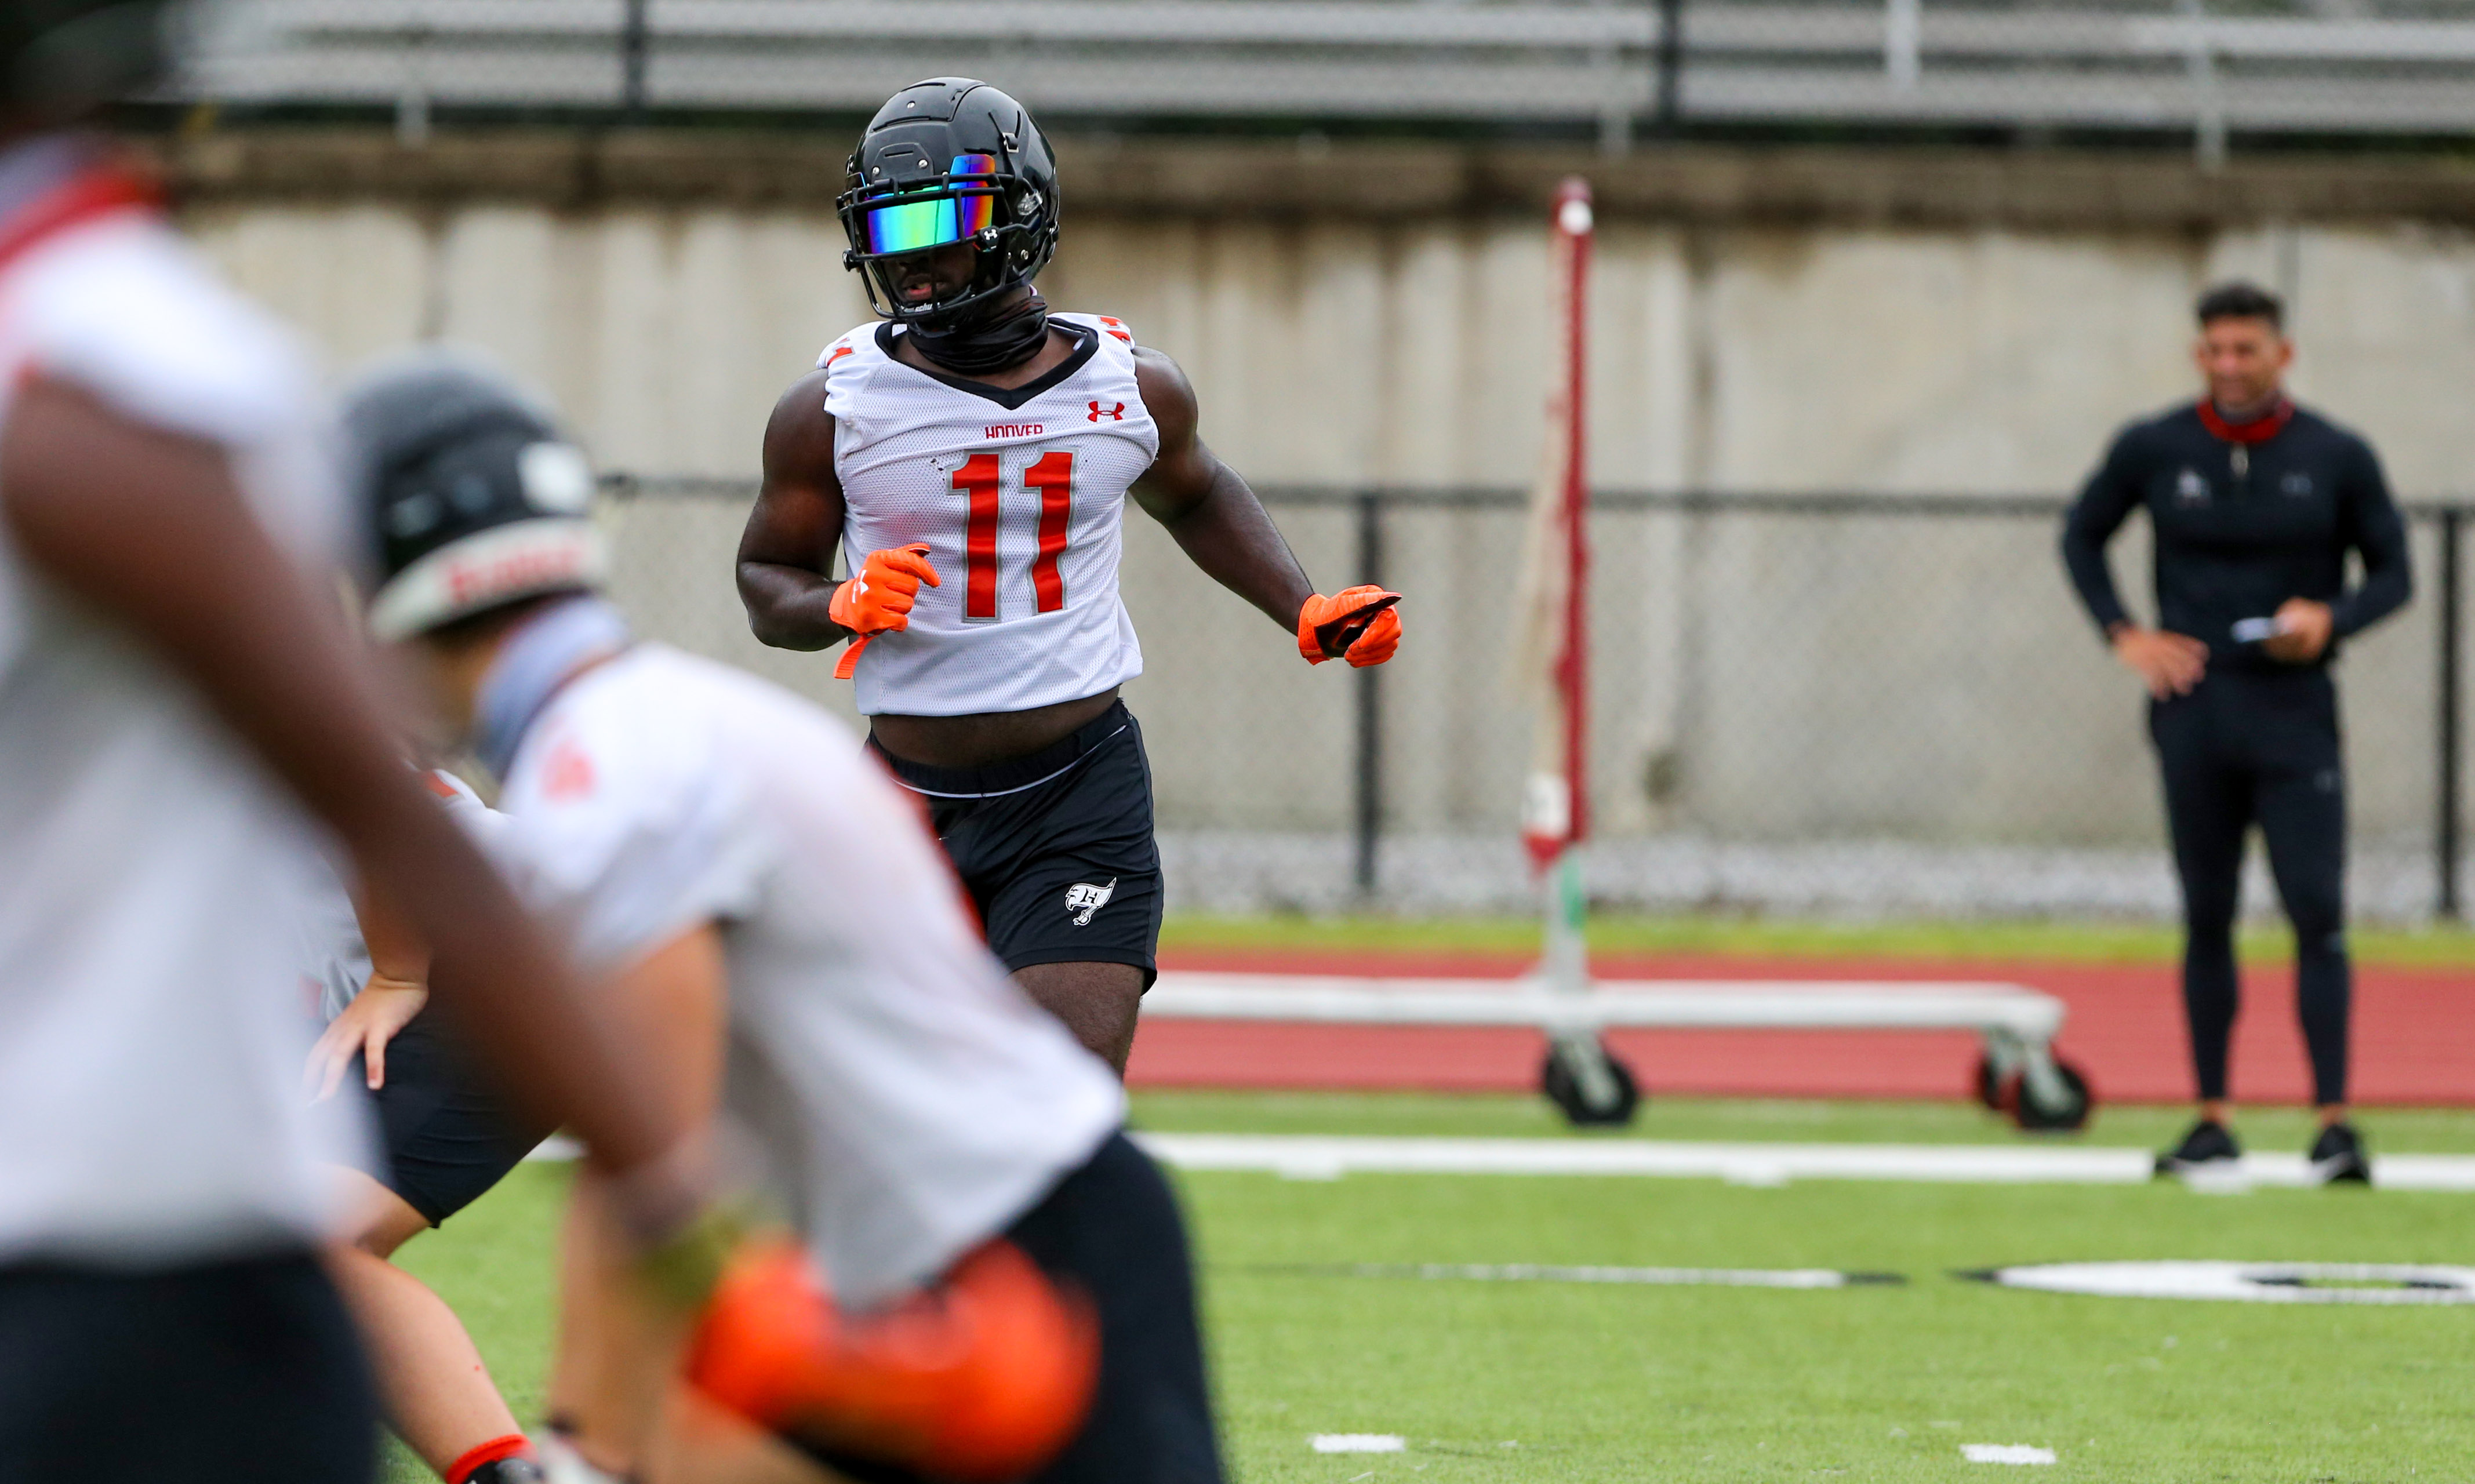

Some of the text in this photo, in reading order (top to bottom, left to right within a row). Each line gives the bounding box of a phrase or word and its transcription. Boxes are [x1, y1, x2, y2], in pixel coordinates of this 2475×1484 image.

[915, 302, 940, 312] schu
[946, 447, 1079, 623] 11
[1080, 888, 1099, 904] H
